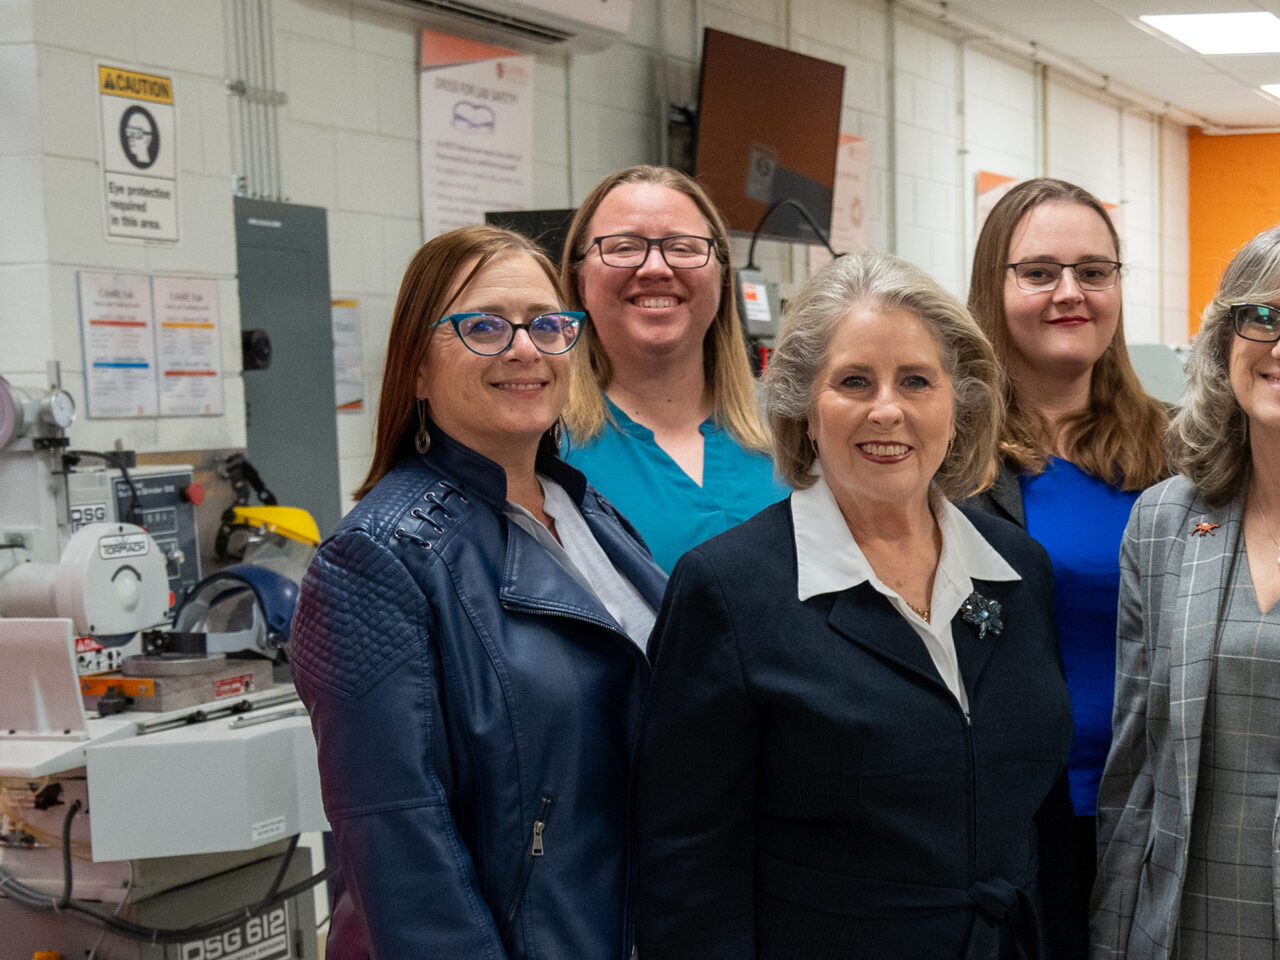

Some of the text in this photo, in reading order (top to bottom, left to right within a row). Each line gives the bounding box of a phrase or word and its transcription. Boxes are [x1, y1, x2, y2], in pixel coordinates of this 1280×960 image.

[115, 74, 169, 98] CAUTION
[108, 182, 171, 200] Eye protection
[110, 200, 147, 213] required
[111, 214, 120, 226] in
[121, 215, 138, 228] this
[102, 541, 146, 556] TORMACH
[246, 907, 286, 945] 612
